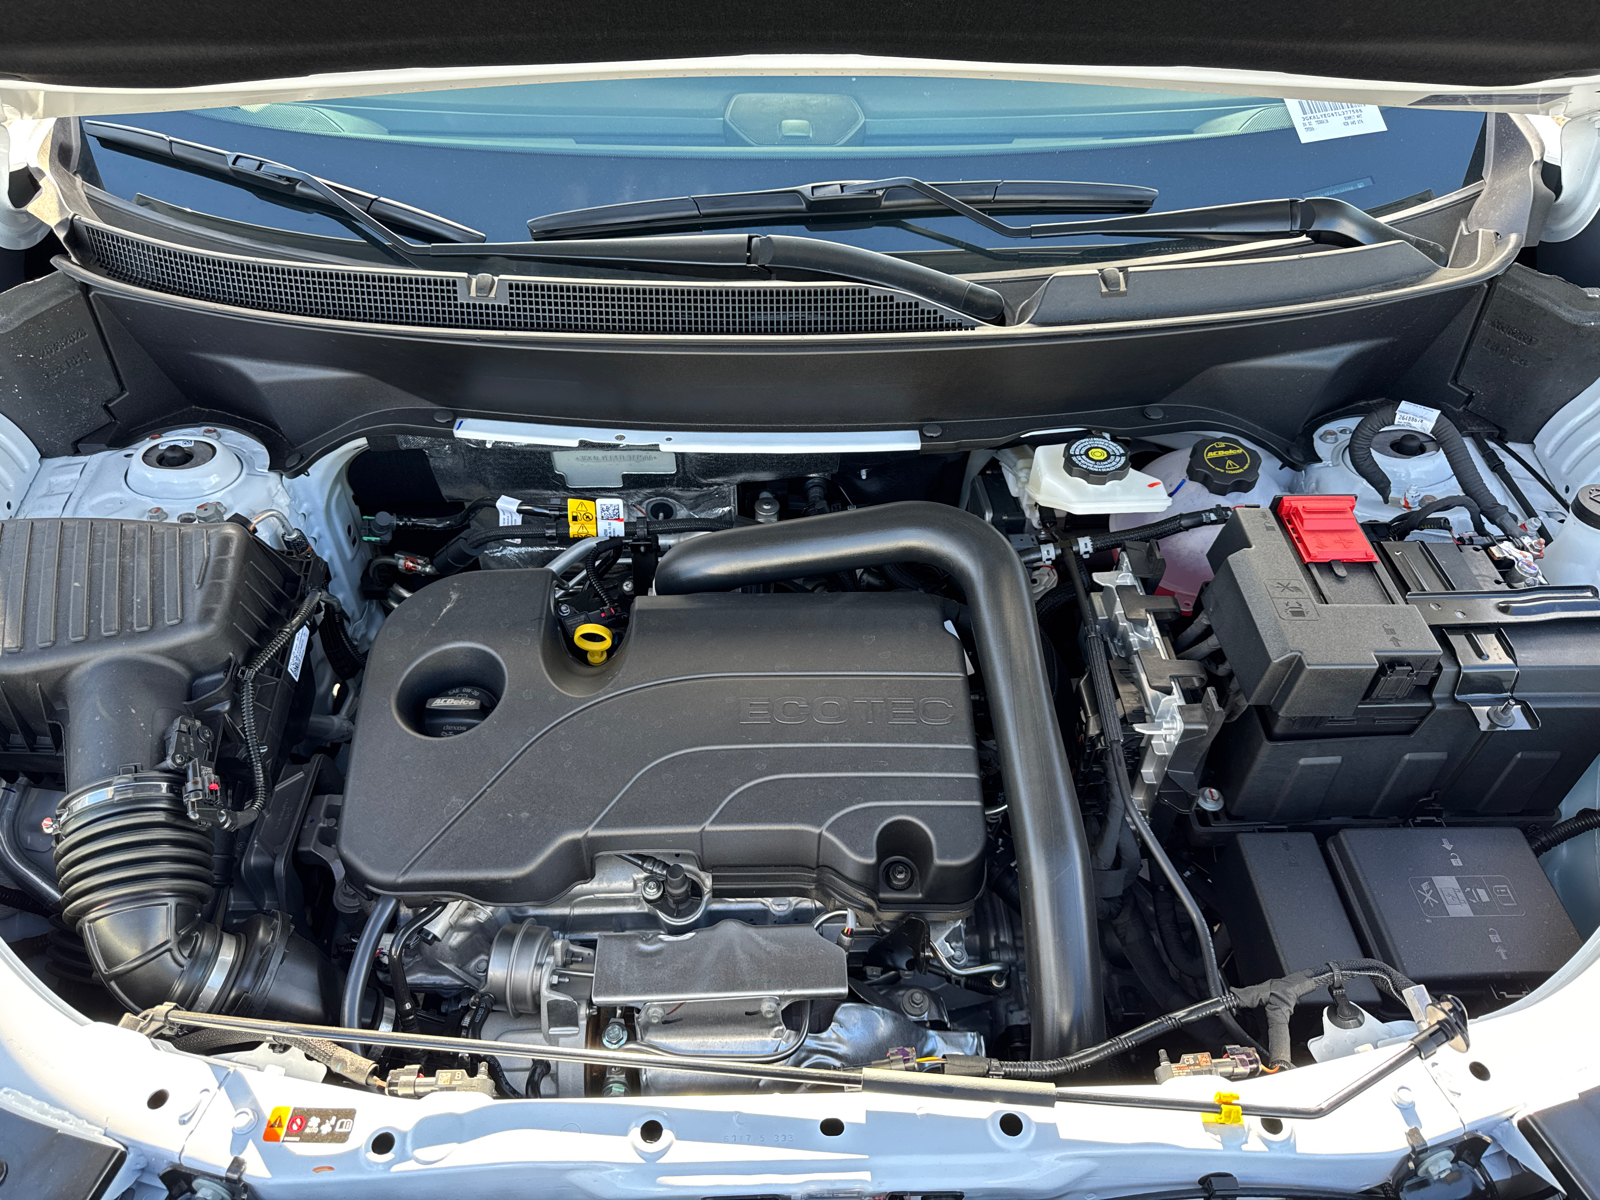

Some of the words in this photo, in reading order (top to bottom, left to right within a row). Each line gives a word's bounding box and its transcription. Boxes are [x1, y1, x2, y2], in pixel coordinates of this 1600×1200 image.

[1207, 449, 1243, 459] ACDelco
[462, 688, 480, 696] 0W-20
[431, 698, 476, 706] ACDelco
[739, 696, 954, 725] ECOTEC
[455, 1071, 462, 1080] B
